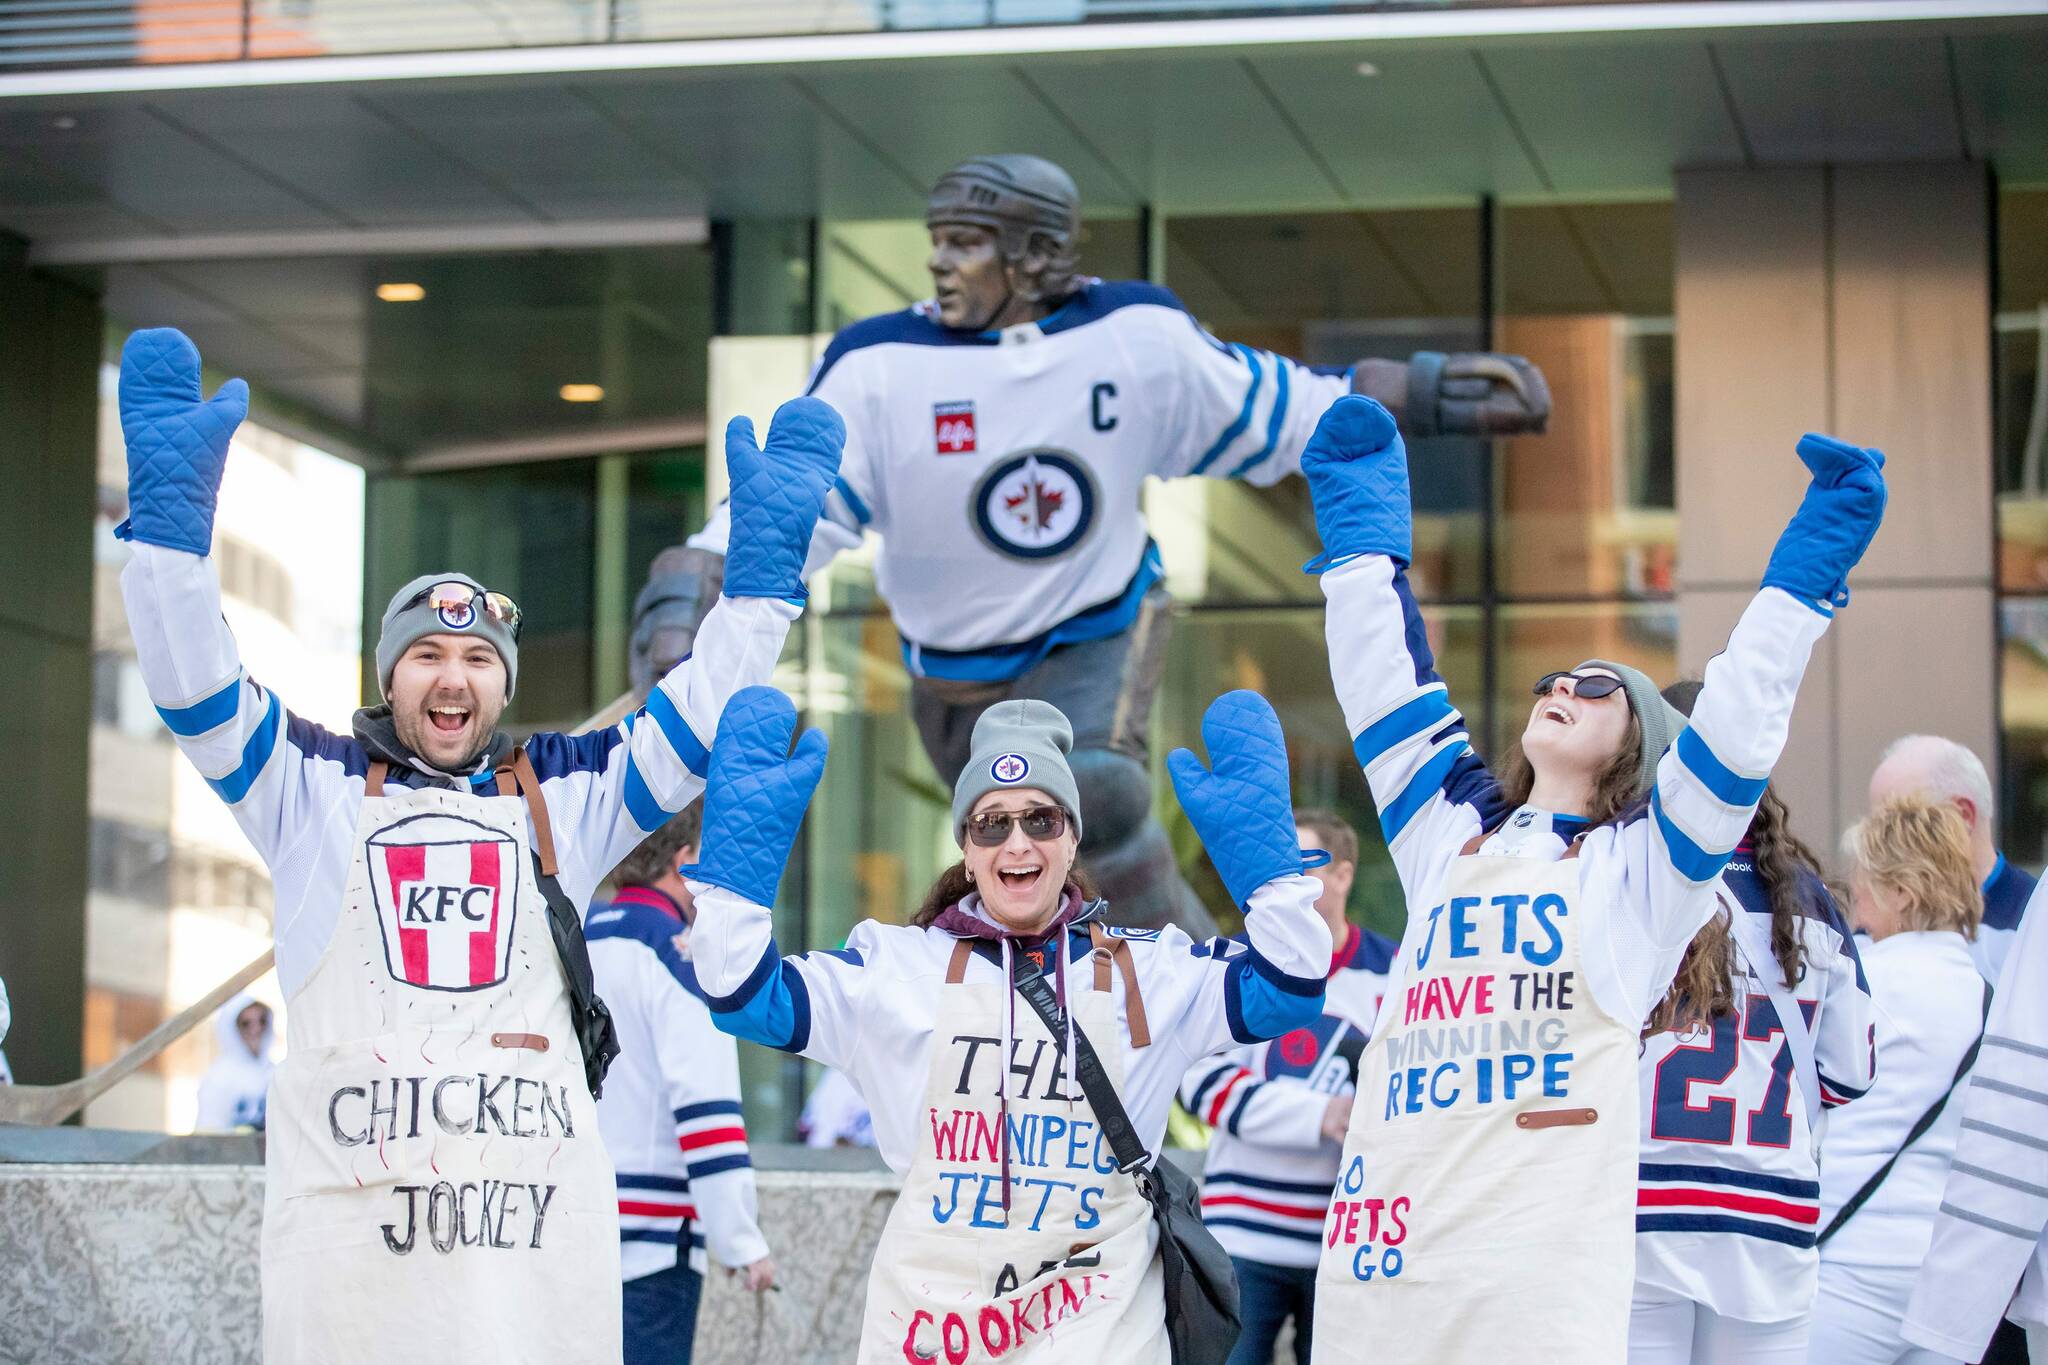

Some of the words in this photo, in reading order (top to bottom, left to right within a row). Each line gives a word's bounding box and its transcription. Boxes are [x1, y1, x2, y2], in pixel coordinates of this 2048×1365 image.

[1091, 382, 1118, 432] C
[1725, 861, 1752, 872] ebok
[404, 886, 490, 923] KFC
[1416, 893, 1568, 971] JETS
[1404, 975, 1495, 1025] HAVE
[1509, 971, 1573, 1011] THE
[951, 1035, 1086, 1102] THE
[1386, 1018, 1568, 1070] WINNING
[1651, 994, 1817, 1148] 27
[328, 1073, 575, 1146] CHICKEN
[1385, 1053, 1573, 1121] RECIPE
[930, 1108, 1120, 1174] WINNIPEG
[933, 1172, 1104, 1231] JETS
[1334, 1155, 1363, 1199] O
[381, 1181, 557, 1256] JOCKEY
[1328, 1196, 1410, 1250] JETS
[1353, 1244, 1403, 1281] GO
